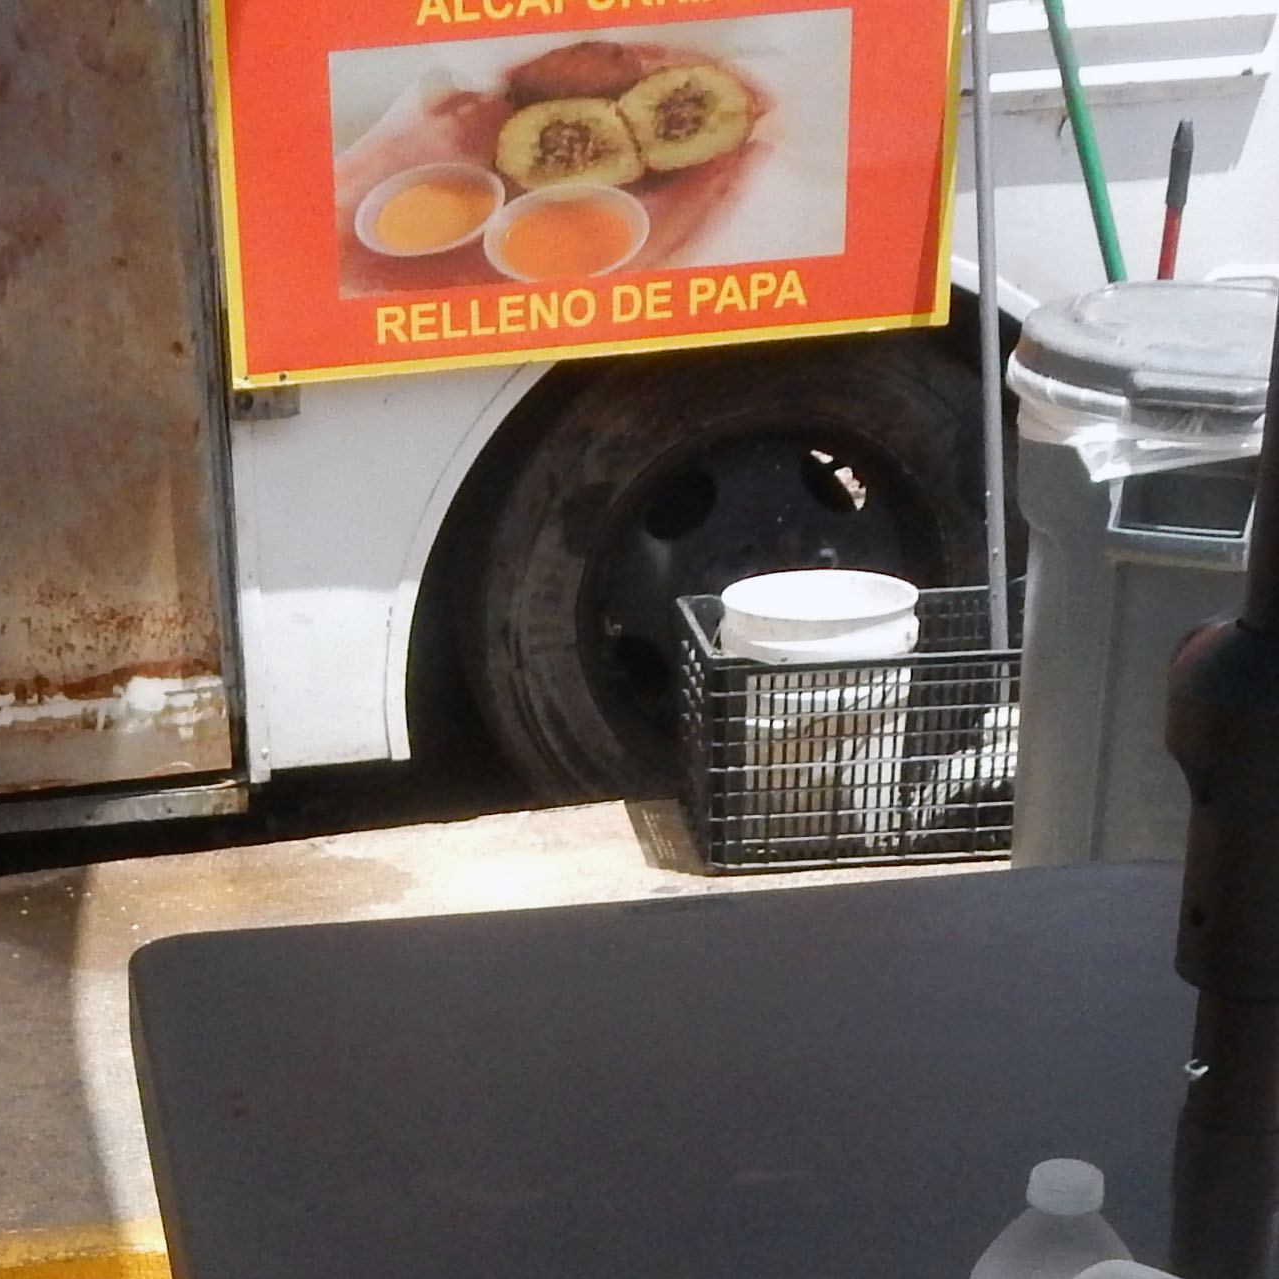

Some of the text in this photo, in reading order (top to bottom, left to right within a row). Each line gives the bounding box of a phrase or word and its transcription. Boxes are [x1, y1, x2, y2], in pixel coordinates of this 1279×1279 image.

[375, 269, 807, 344] RELLENO DE PAPA
